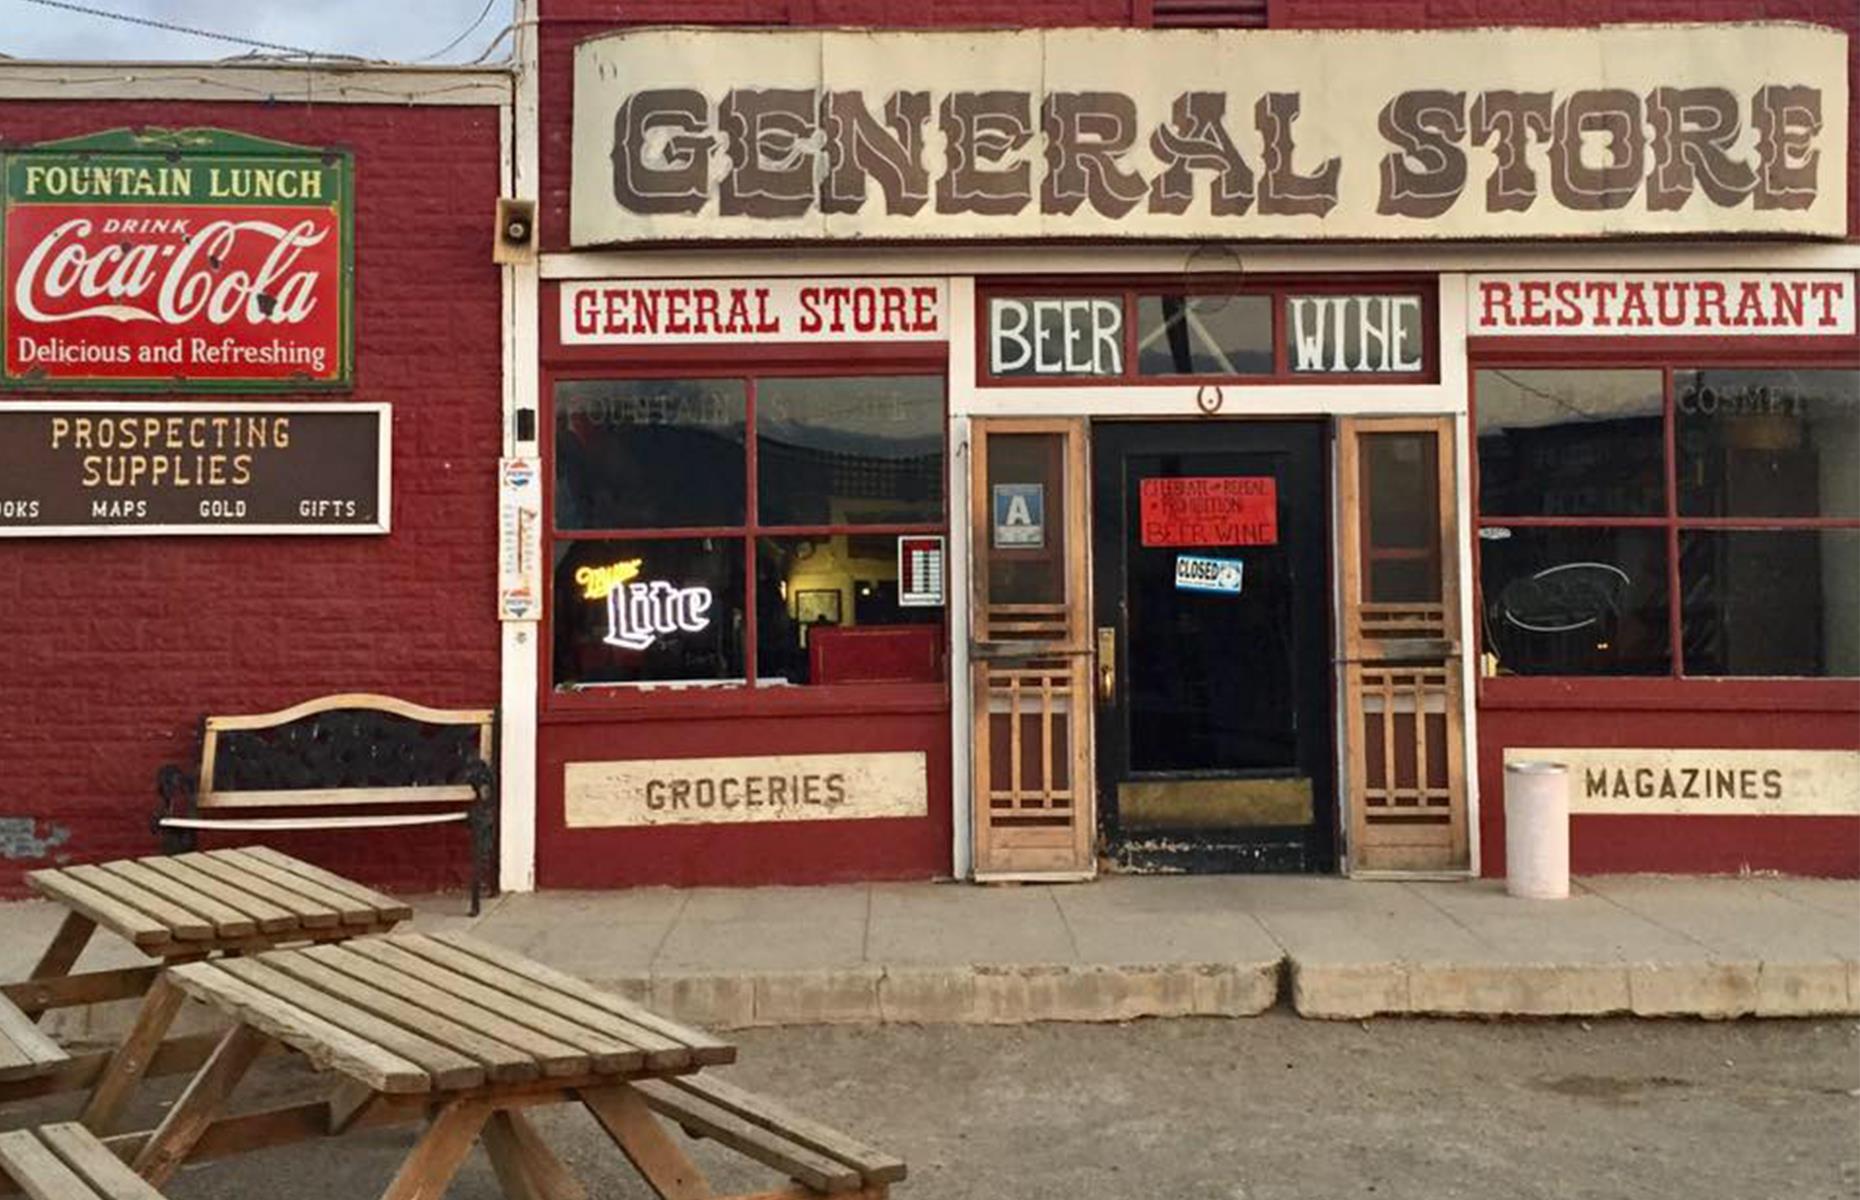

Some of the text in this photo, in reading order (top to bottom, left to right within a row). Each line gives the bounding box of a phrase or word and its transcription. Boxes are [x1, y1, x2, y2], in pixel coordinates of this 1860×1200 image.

[611, 85, 1823, 220] GENERAL STORE
[25, 166, 323, 198] FOUNTAIN LUNCH
[102, 218, 190, 235] DRINK
[574, 286, 938, 336] GENERAL STORE
[1479, 281, 1846, 328] RESTAURANT
[991, 299, 1123, 375] BEER
[1293, 297, 1422, 373] WINE
[18, 336, 326, 371] Delicious and Refreshing
[51, 417, 291, 450] PROSPECTING
[82, 455, 253, 486] SUPPLIES
[0, 500, 357, 518] OKS MAPS GOLD GIFTS
[1006, 495, 1031, 525] A
[1214, 523, 1271, 543] WINE
[1178, 558, 1219, 580] CLOSED
[603, 580, 713, 650] Lite
[645, 773, 847, 810] GROCERIES
[1585, 768, 1783, 799] MAGAZINES
